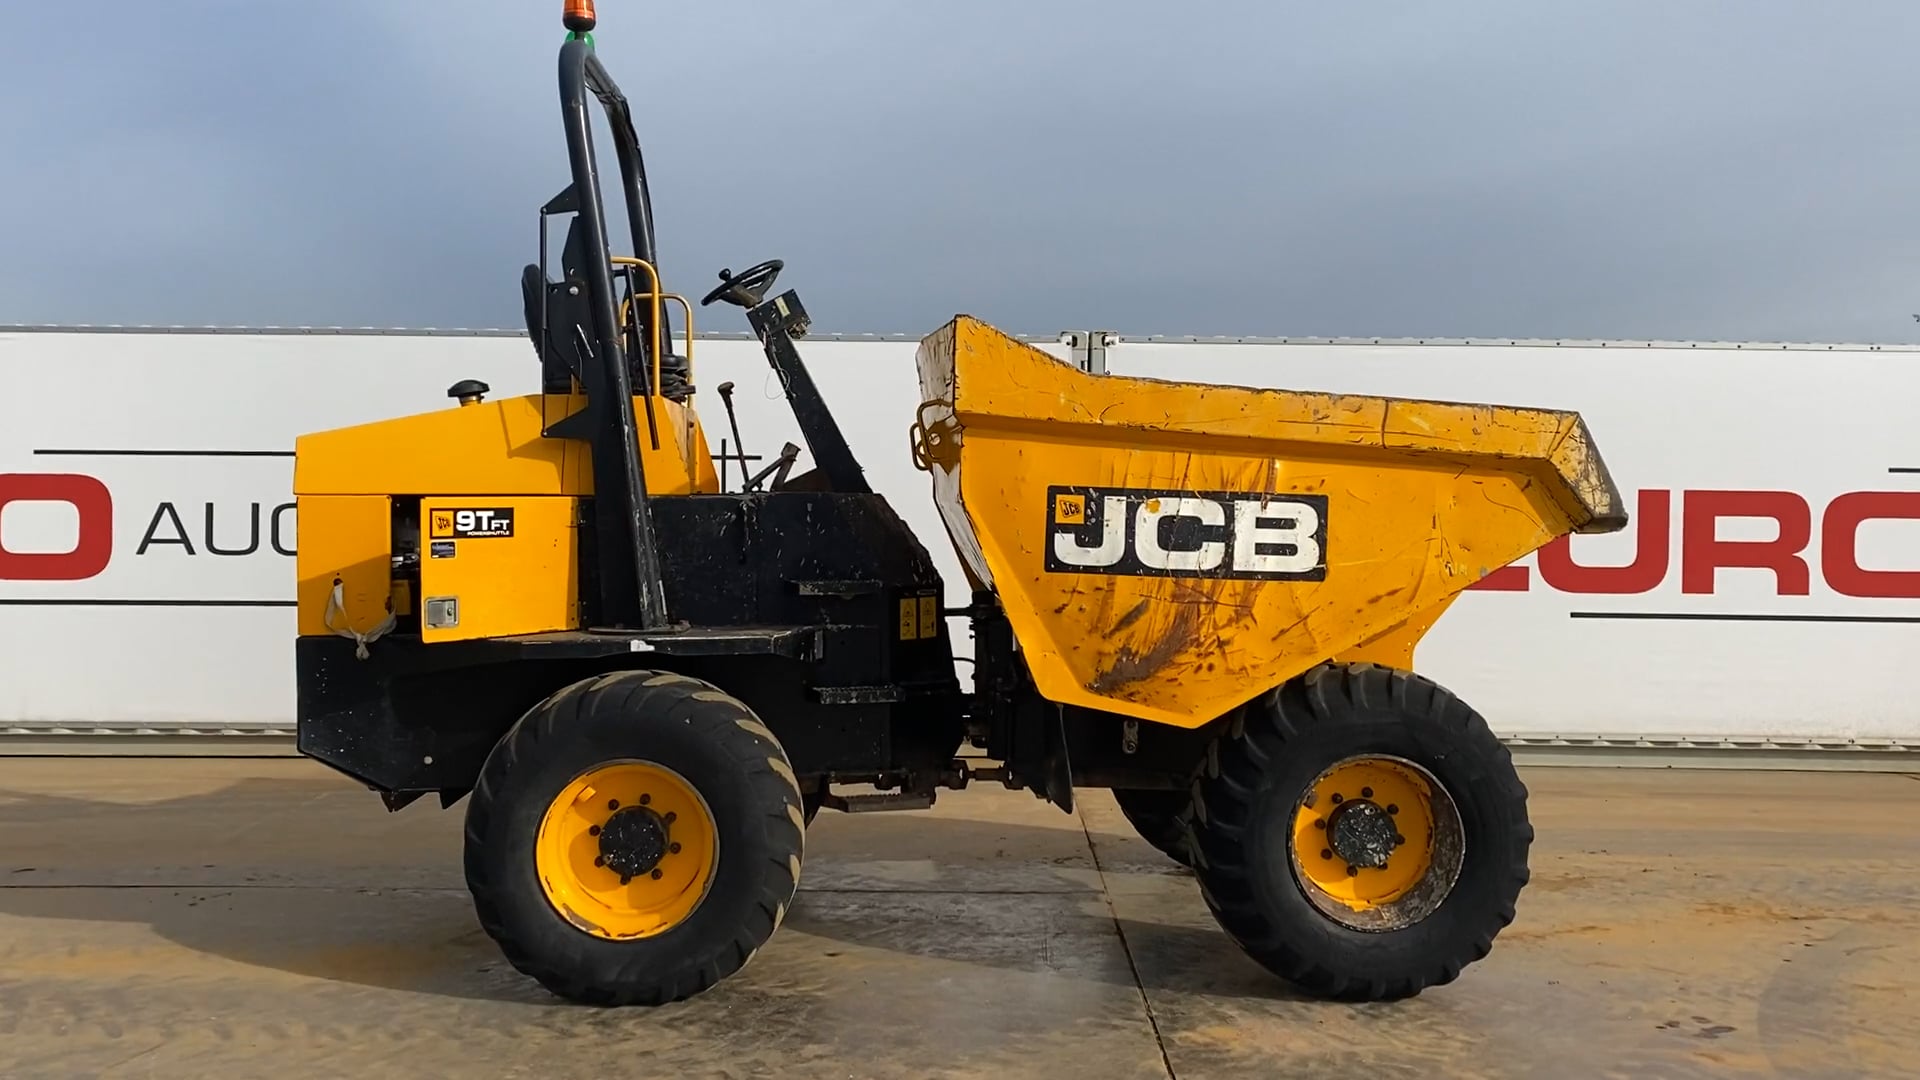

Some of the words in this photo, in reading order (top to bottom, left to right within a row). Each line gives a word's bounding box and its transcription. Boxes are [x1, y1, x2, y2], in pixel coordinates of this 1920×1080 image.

[1054, 496, 1320, 573] JCB
[1060, 500, 1081, 518] JCB
[1462, 489, 1920, 598] URO
